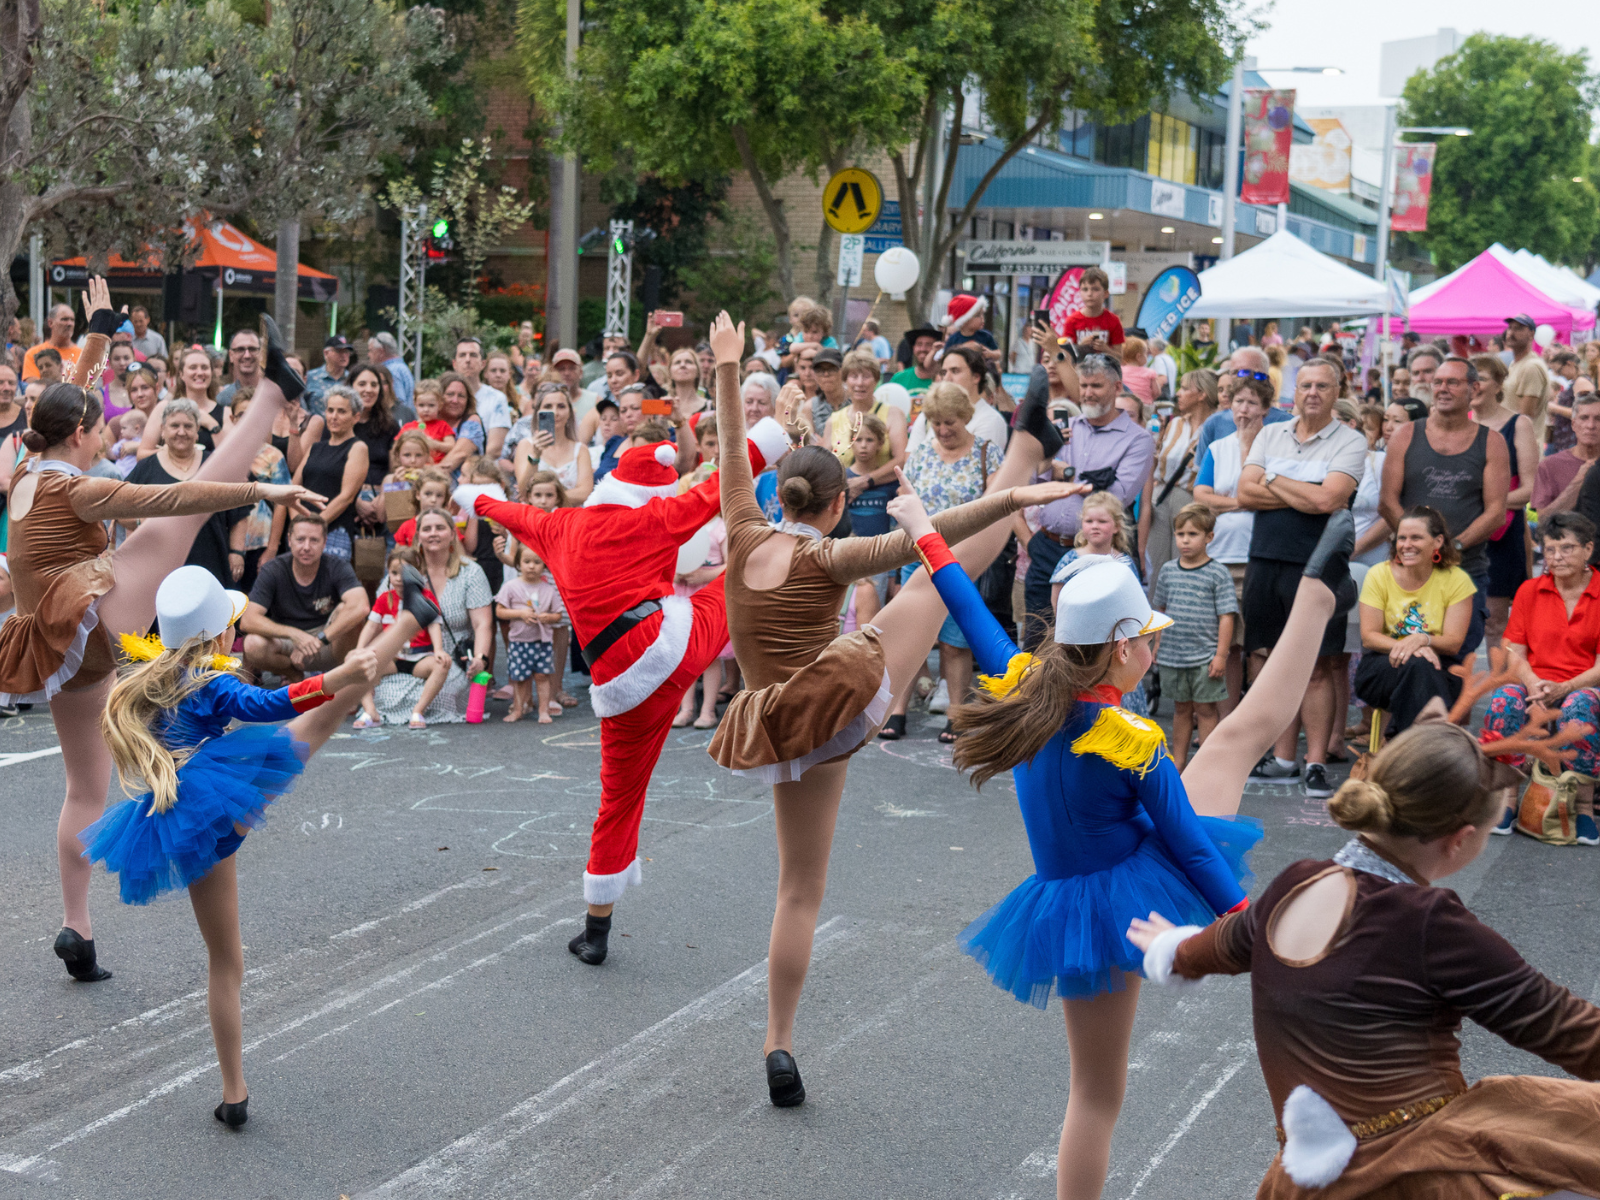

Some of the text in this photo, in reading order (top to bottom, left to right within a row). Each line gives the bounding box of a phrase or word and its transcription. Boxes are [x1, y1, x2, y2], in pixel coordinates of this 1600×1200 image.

[843, 237, 861, 250] 2P
[970, 243, 1037, 262] California
[1049, 274, 1079, 324] FAIRY
[1176, 287, 1198, 313] ICE
